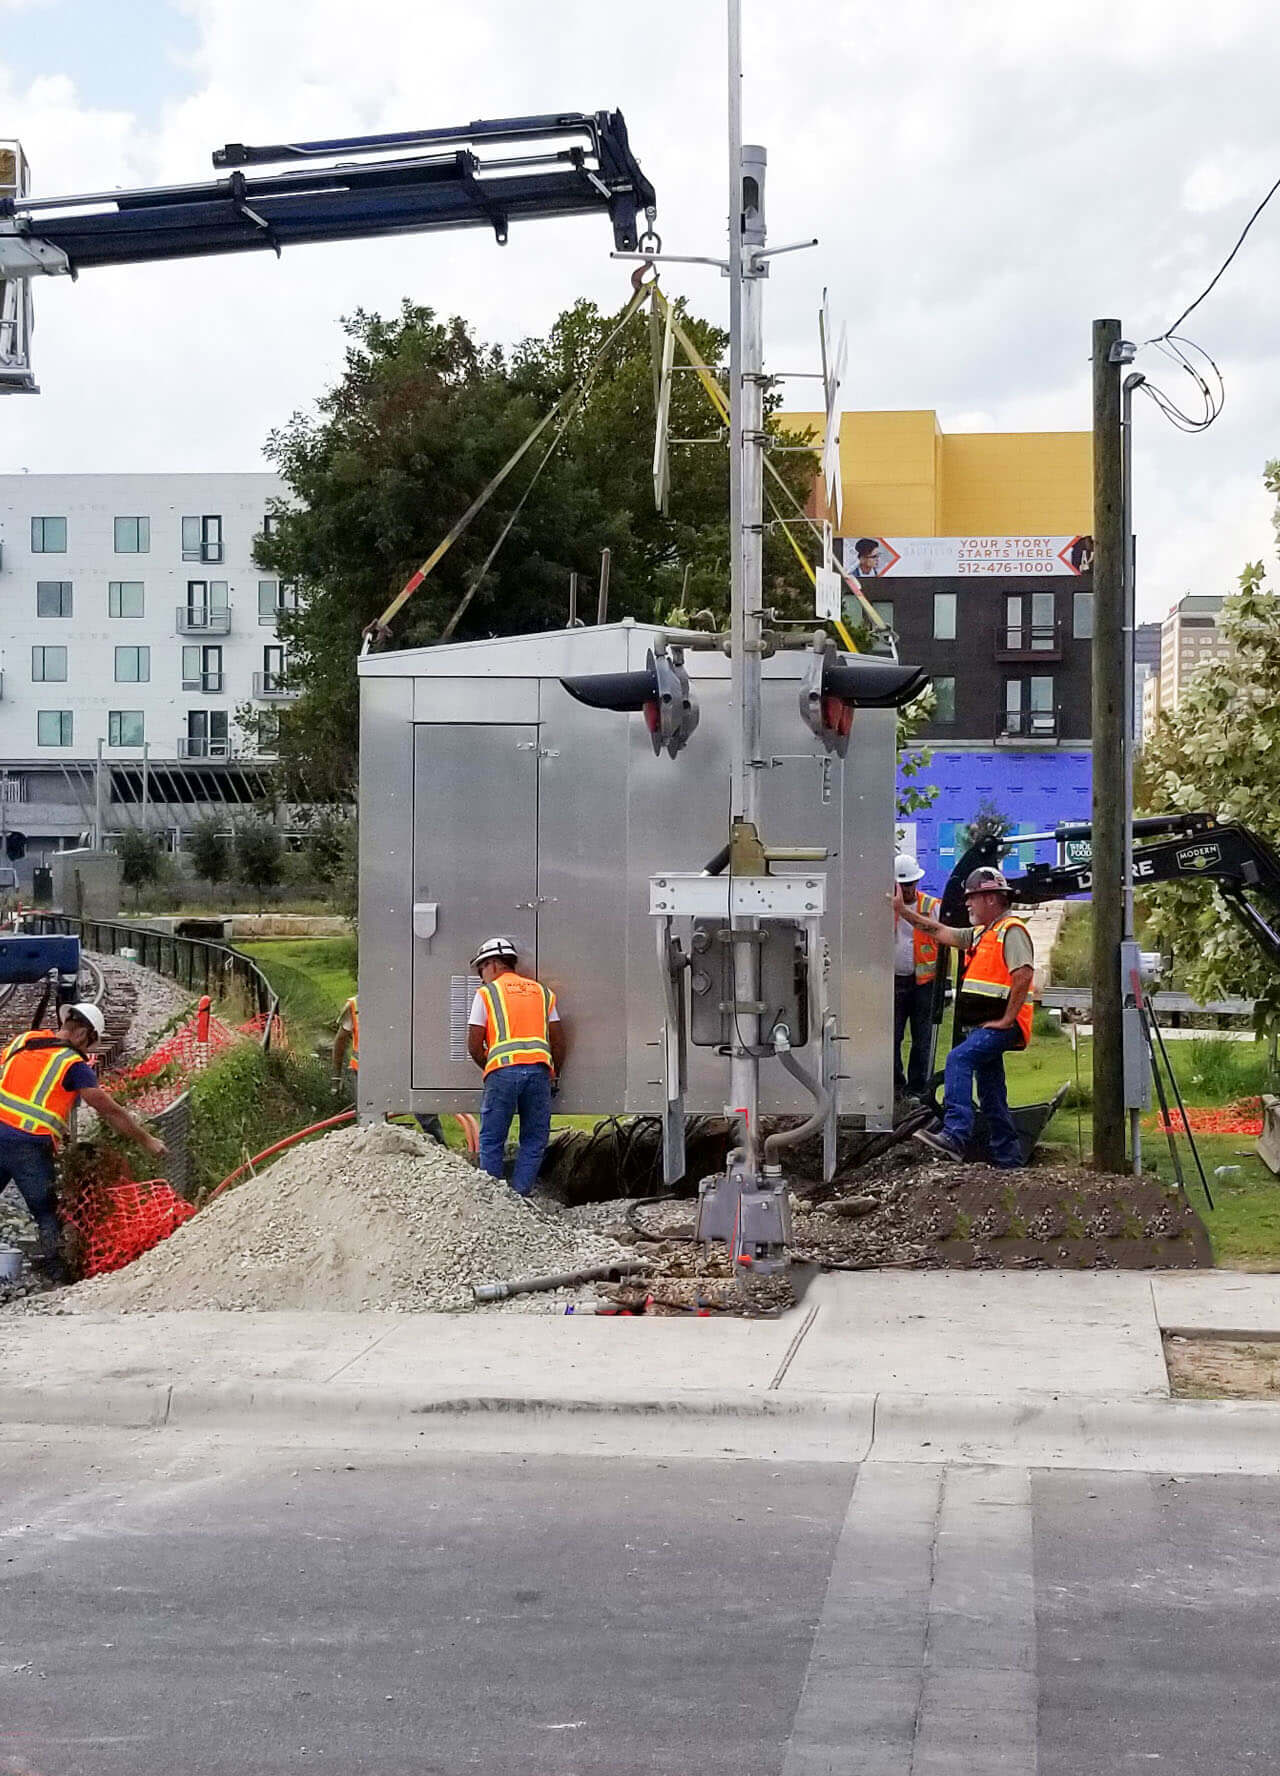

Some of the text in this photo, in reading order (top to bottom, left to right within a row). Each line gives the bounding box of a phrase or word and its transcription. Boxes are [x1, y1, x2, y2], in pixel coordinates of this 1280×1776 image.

[960, 539, 1051, 548] YOUR STORY
[958, 549, 1010, 558] STARTS
[1016, 548, 1053, 558] HERE
[958, 562, 1054, 573] 512-476-1000
[1179, 846, 1216, 860] MODERN
